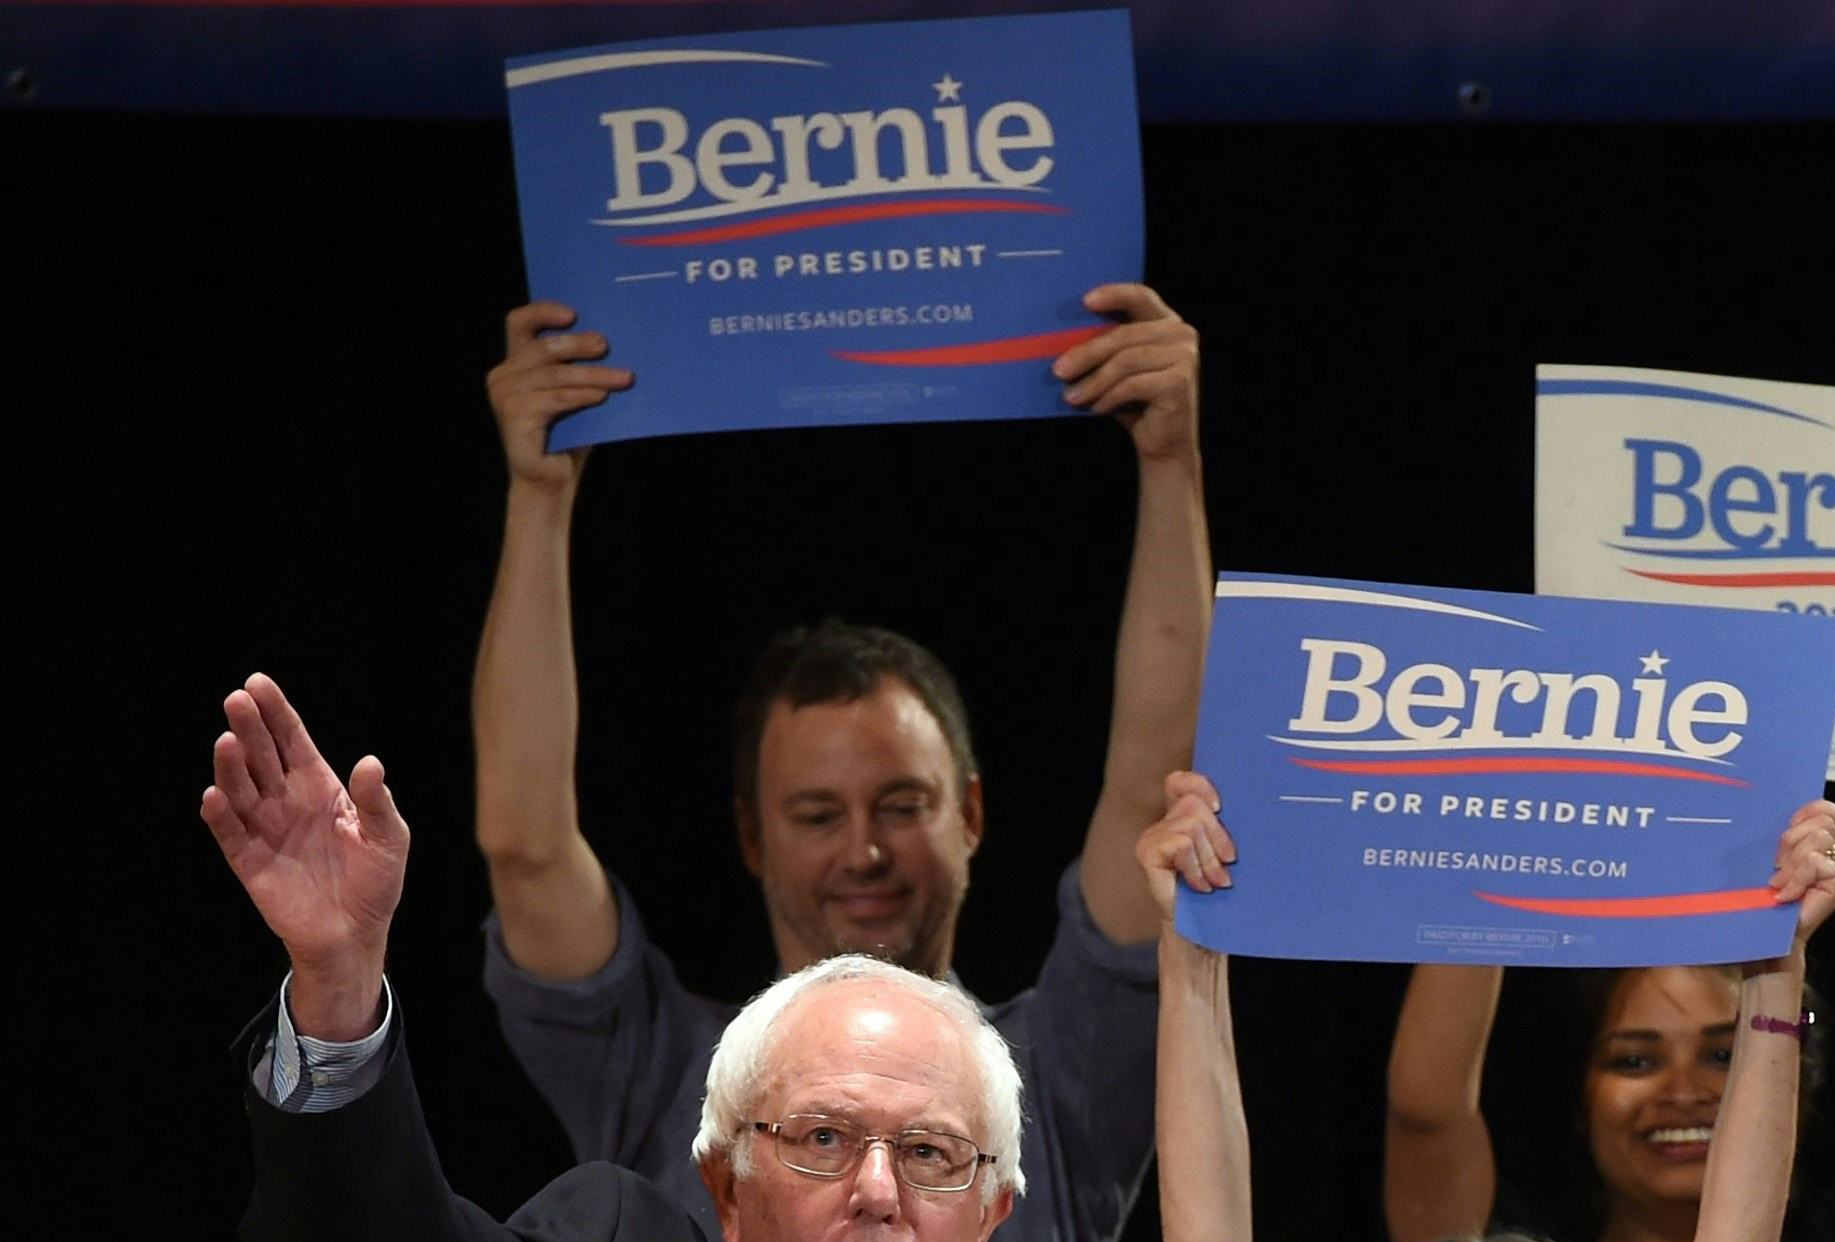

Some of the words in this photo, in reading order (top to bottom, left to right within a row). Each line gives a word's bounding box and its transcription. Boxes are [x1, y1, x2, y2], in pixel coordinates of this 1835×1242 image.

[600, 74, 1056, 212] Bernie
[685, 257, 759, 283] FOR
[776, 245, 988, 276] PRESIDENT
[709, 304, 974, 336] BERNIESANDERS.COM
[1288, 638, 1749, 758] Bernie
[1351, 791, 1423, 816] FOR
[1441, 795, 1656, 829] PRESIDENT
[1362, 848, 1629, 879] BERNIESANDERS.COM
